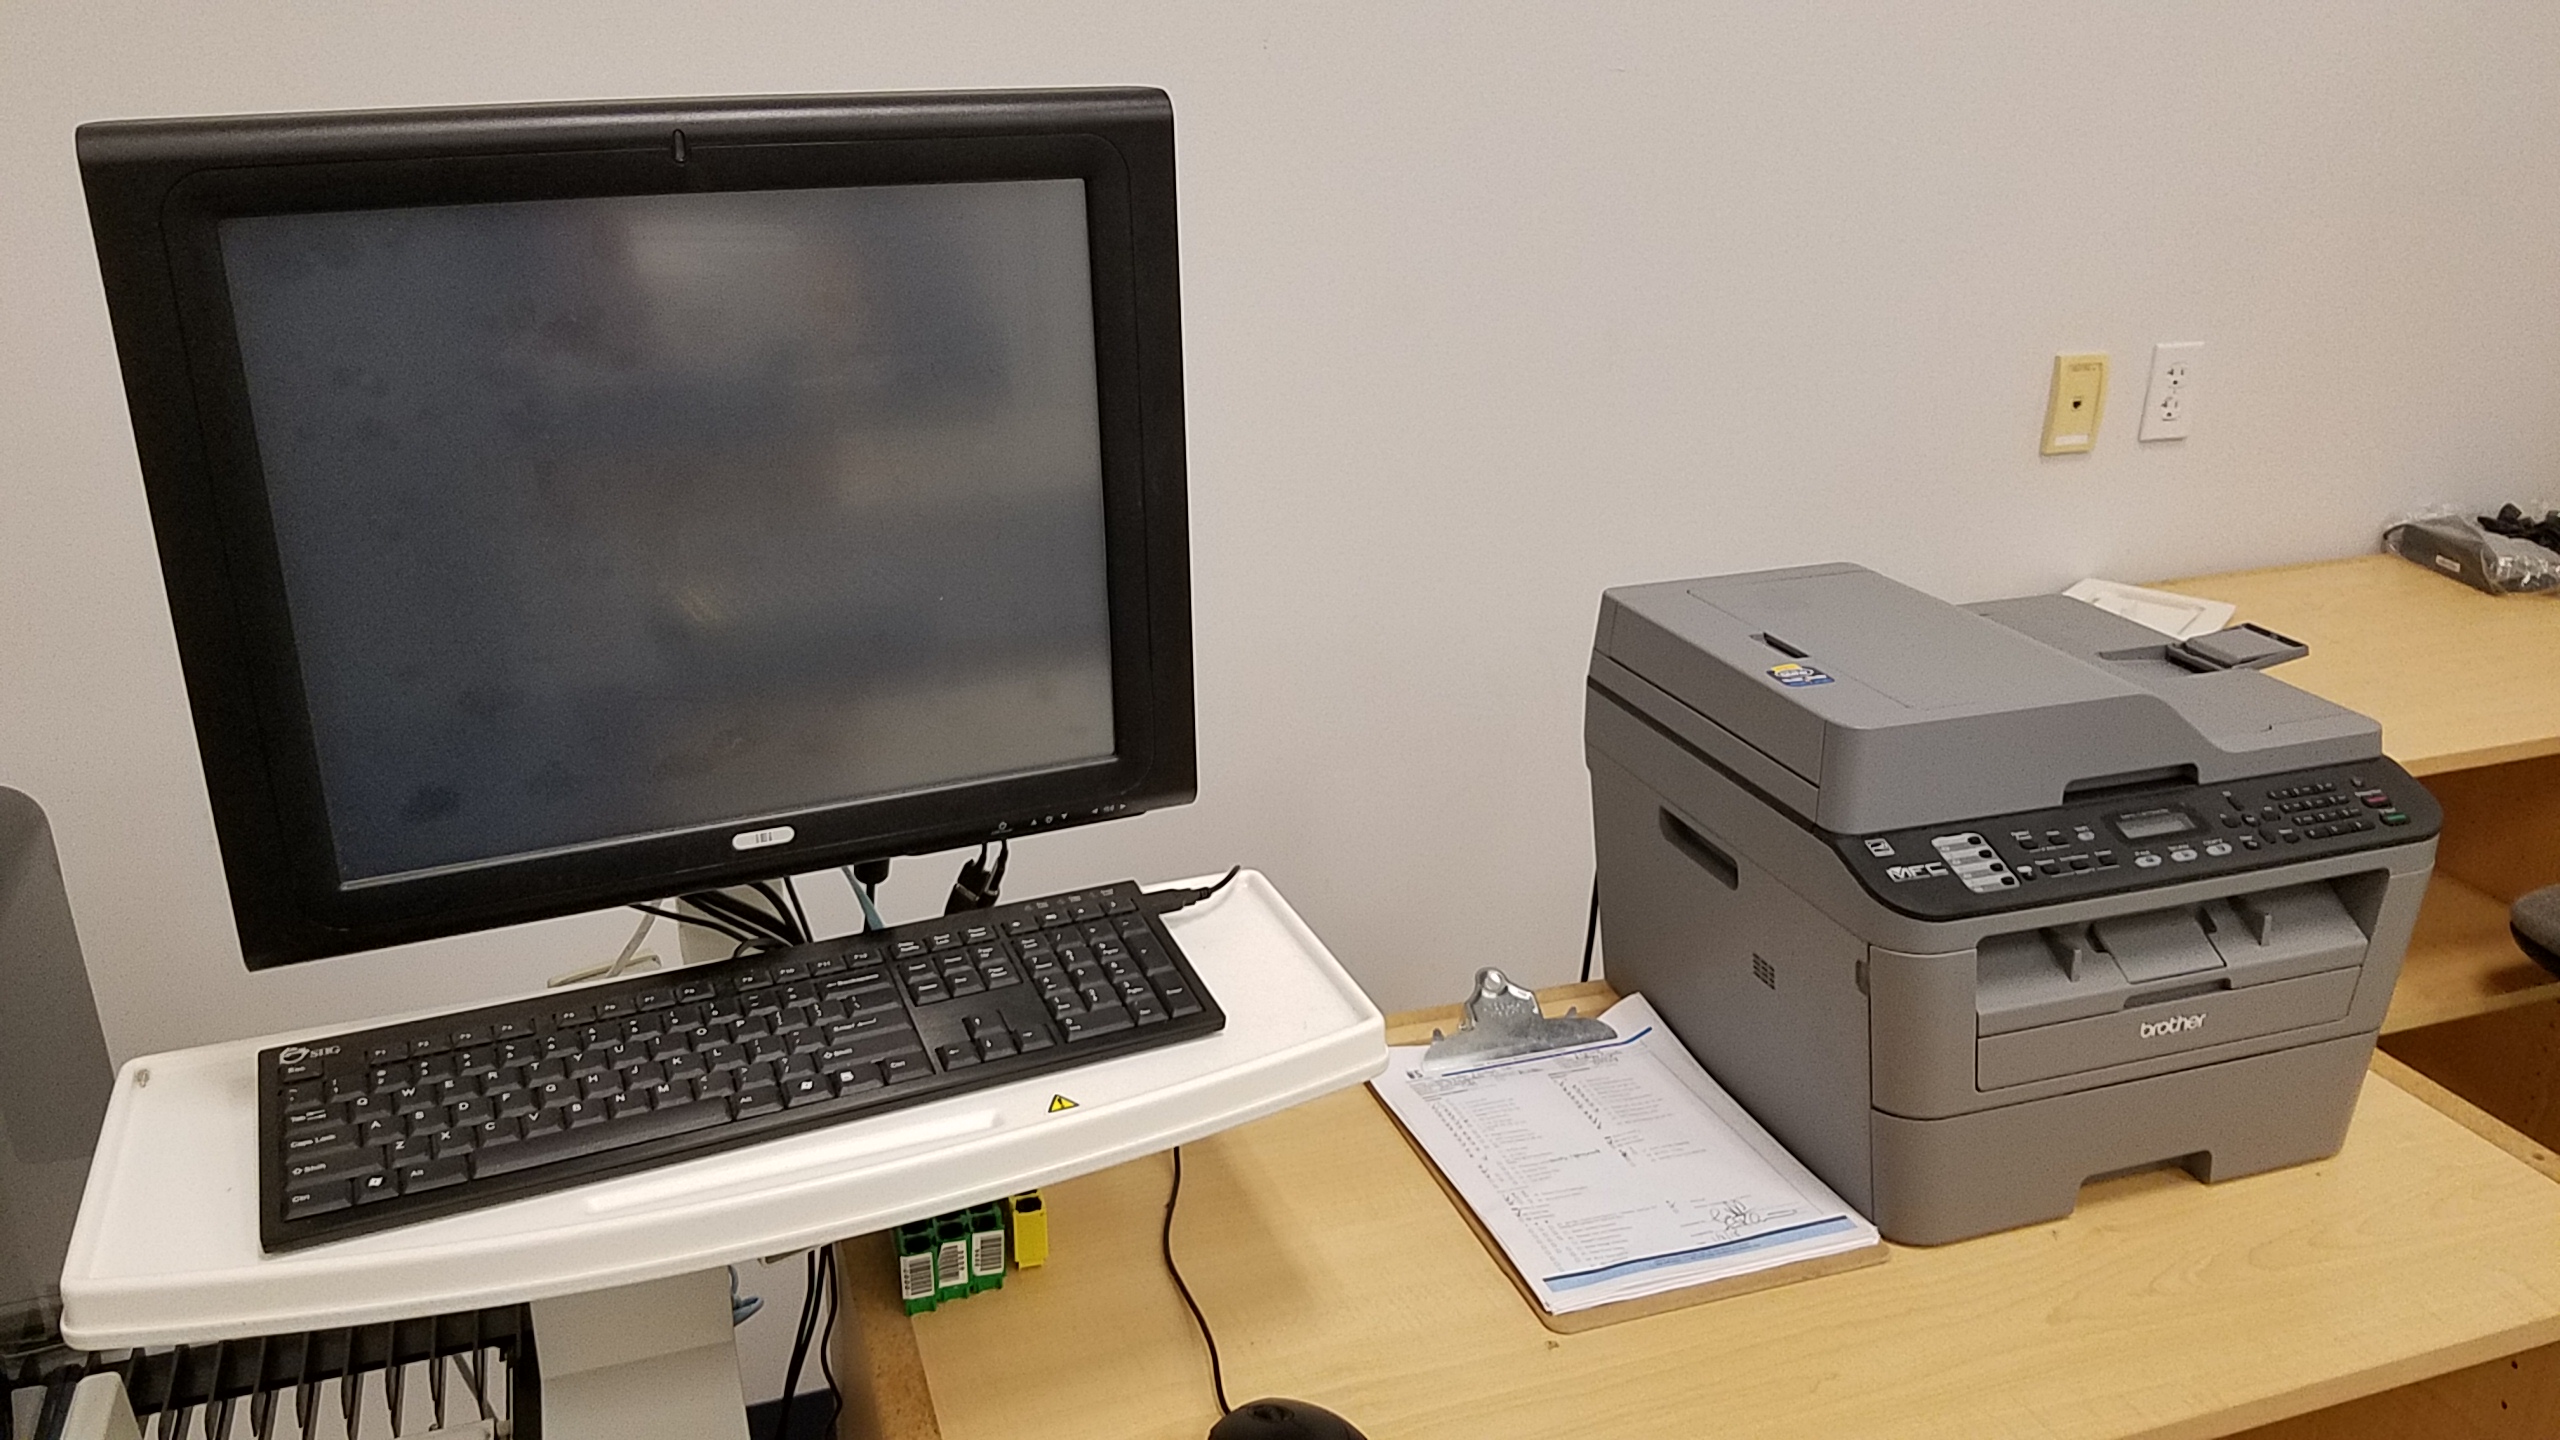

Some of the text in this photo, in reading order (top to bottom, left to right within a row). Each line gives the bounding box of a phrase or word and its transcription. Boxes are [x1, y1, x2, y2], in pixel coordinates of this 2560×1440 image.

[1886, 861, 1949, 883] MFC
[736, 1019, 746, 1028] P
[2140, 1013, 2207, 1039] brother
[696, 1027, 708, 1036] O
[613, 1044, 625, 1053] U
[712, 1048, 722, 1057] L
[573, 1053, 583, 1062] Y
[672, 1057, 682, 1065] K
[530, 1062, 540, 1071] T
[631, 1065, 639, 1075] J
[588, 1074, 599, 1083] H
[401, 1087, 416, 1097] W
[657, 1084, 670, 1093] M
[502, 1092, 511, 1102] F
[615, 1093, 626, 1103] N
[458, 1101, 469, 1111] D
[572, 1103, 582, 1112] B
[528, 1112, 539, 1121] V
[370, 1120, 382, 1129] A
[484, 1121, 496, 1131] C
[440, 1130, 451, 1141] X
[395, 1140, 405, 1150] Z
